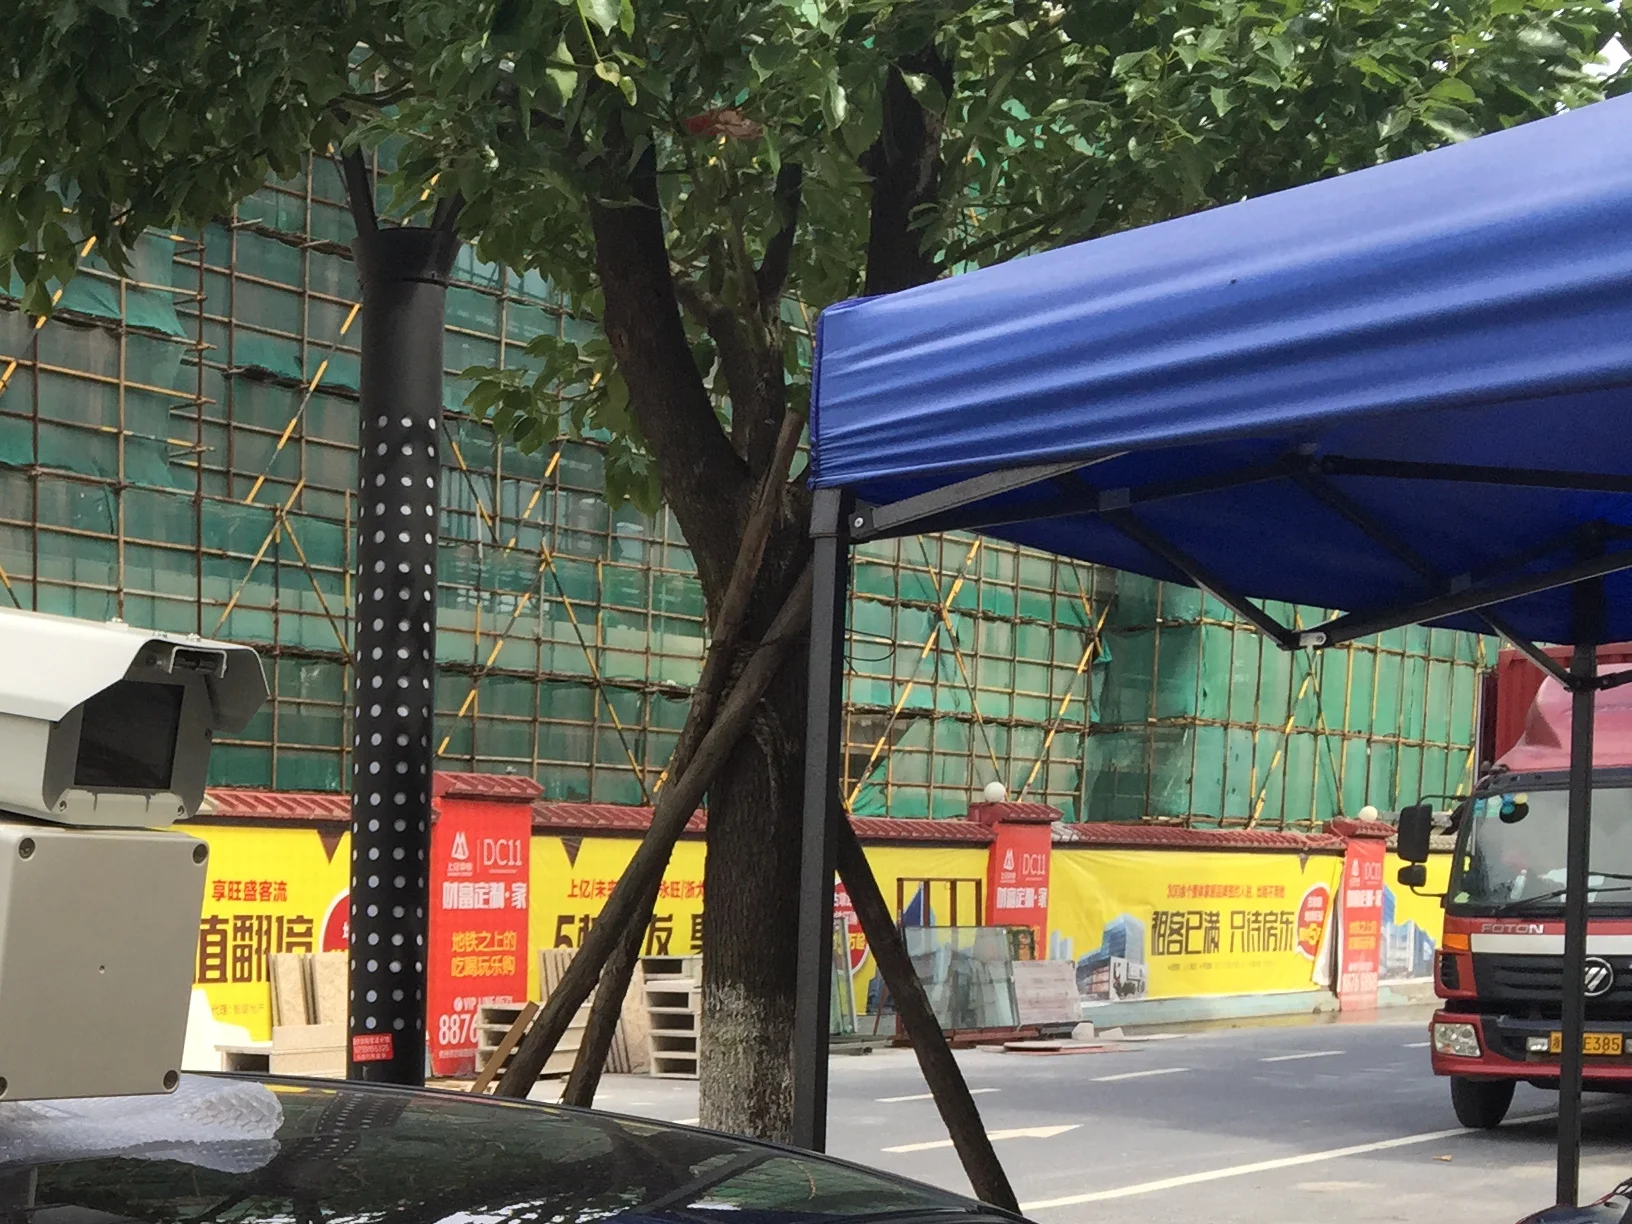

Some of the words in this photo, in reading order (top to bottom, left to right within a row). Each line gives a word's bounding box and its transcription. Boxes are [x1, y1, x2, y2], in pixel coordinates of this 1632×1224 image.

[483, 839, 522, 865] DC11
[212, 880, 288, 902] 享旺盛客流
[1230, 911, 1294, 953] 只待房东
[1481, 924, 1544, 934] FOTON
[451, 931, 517, 952] 地铁之上的
[451, 956, 516, 977] 吃喝玩乐购
